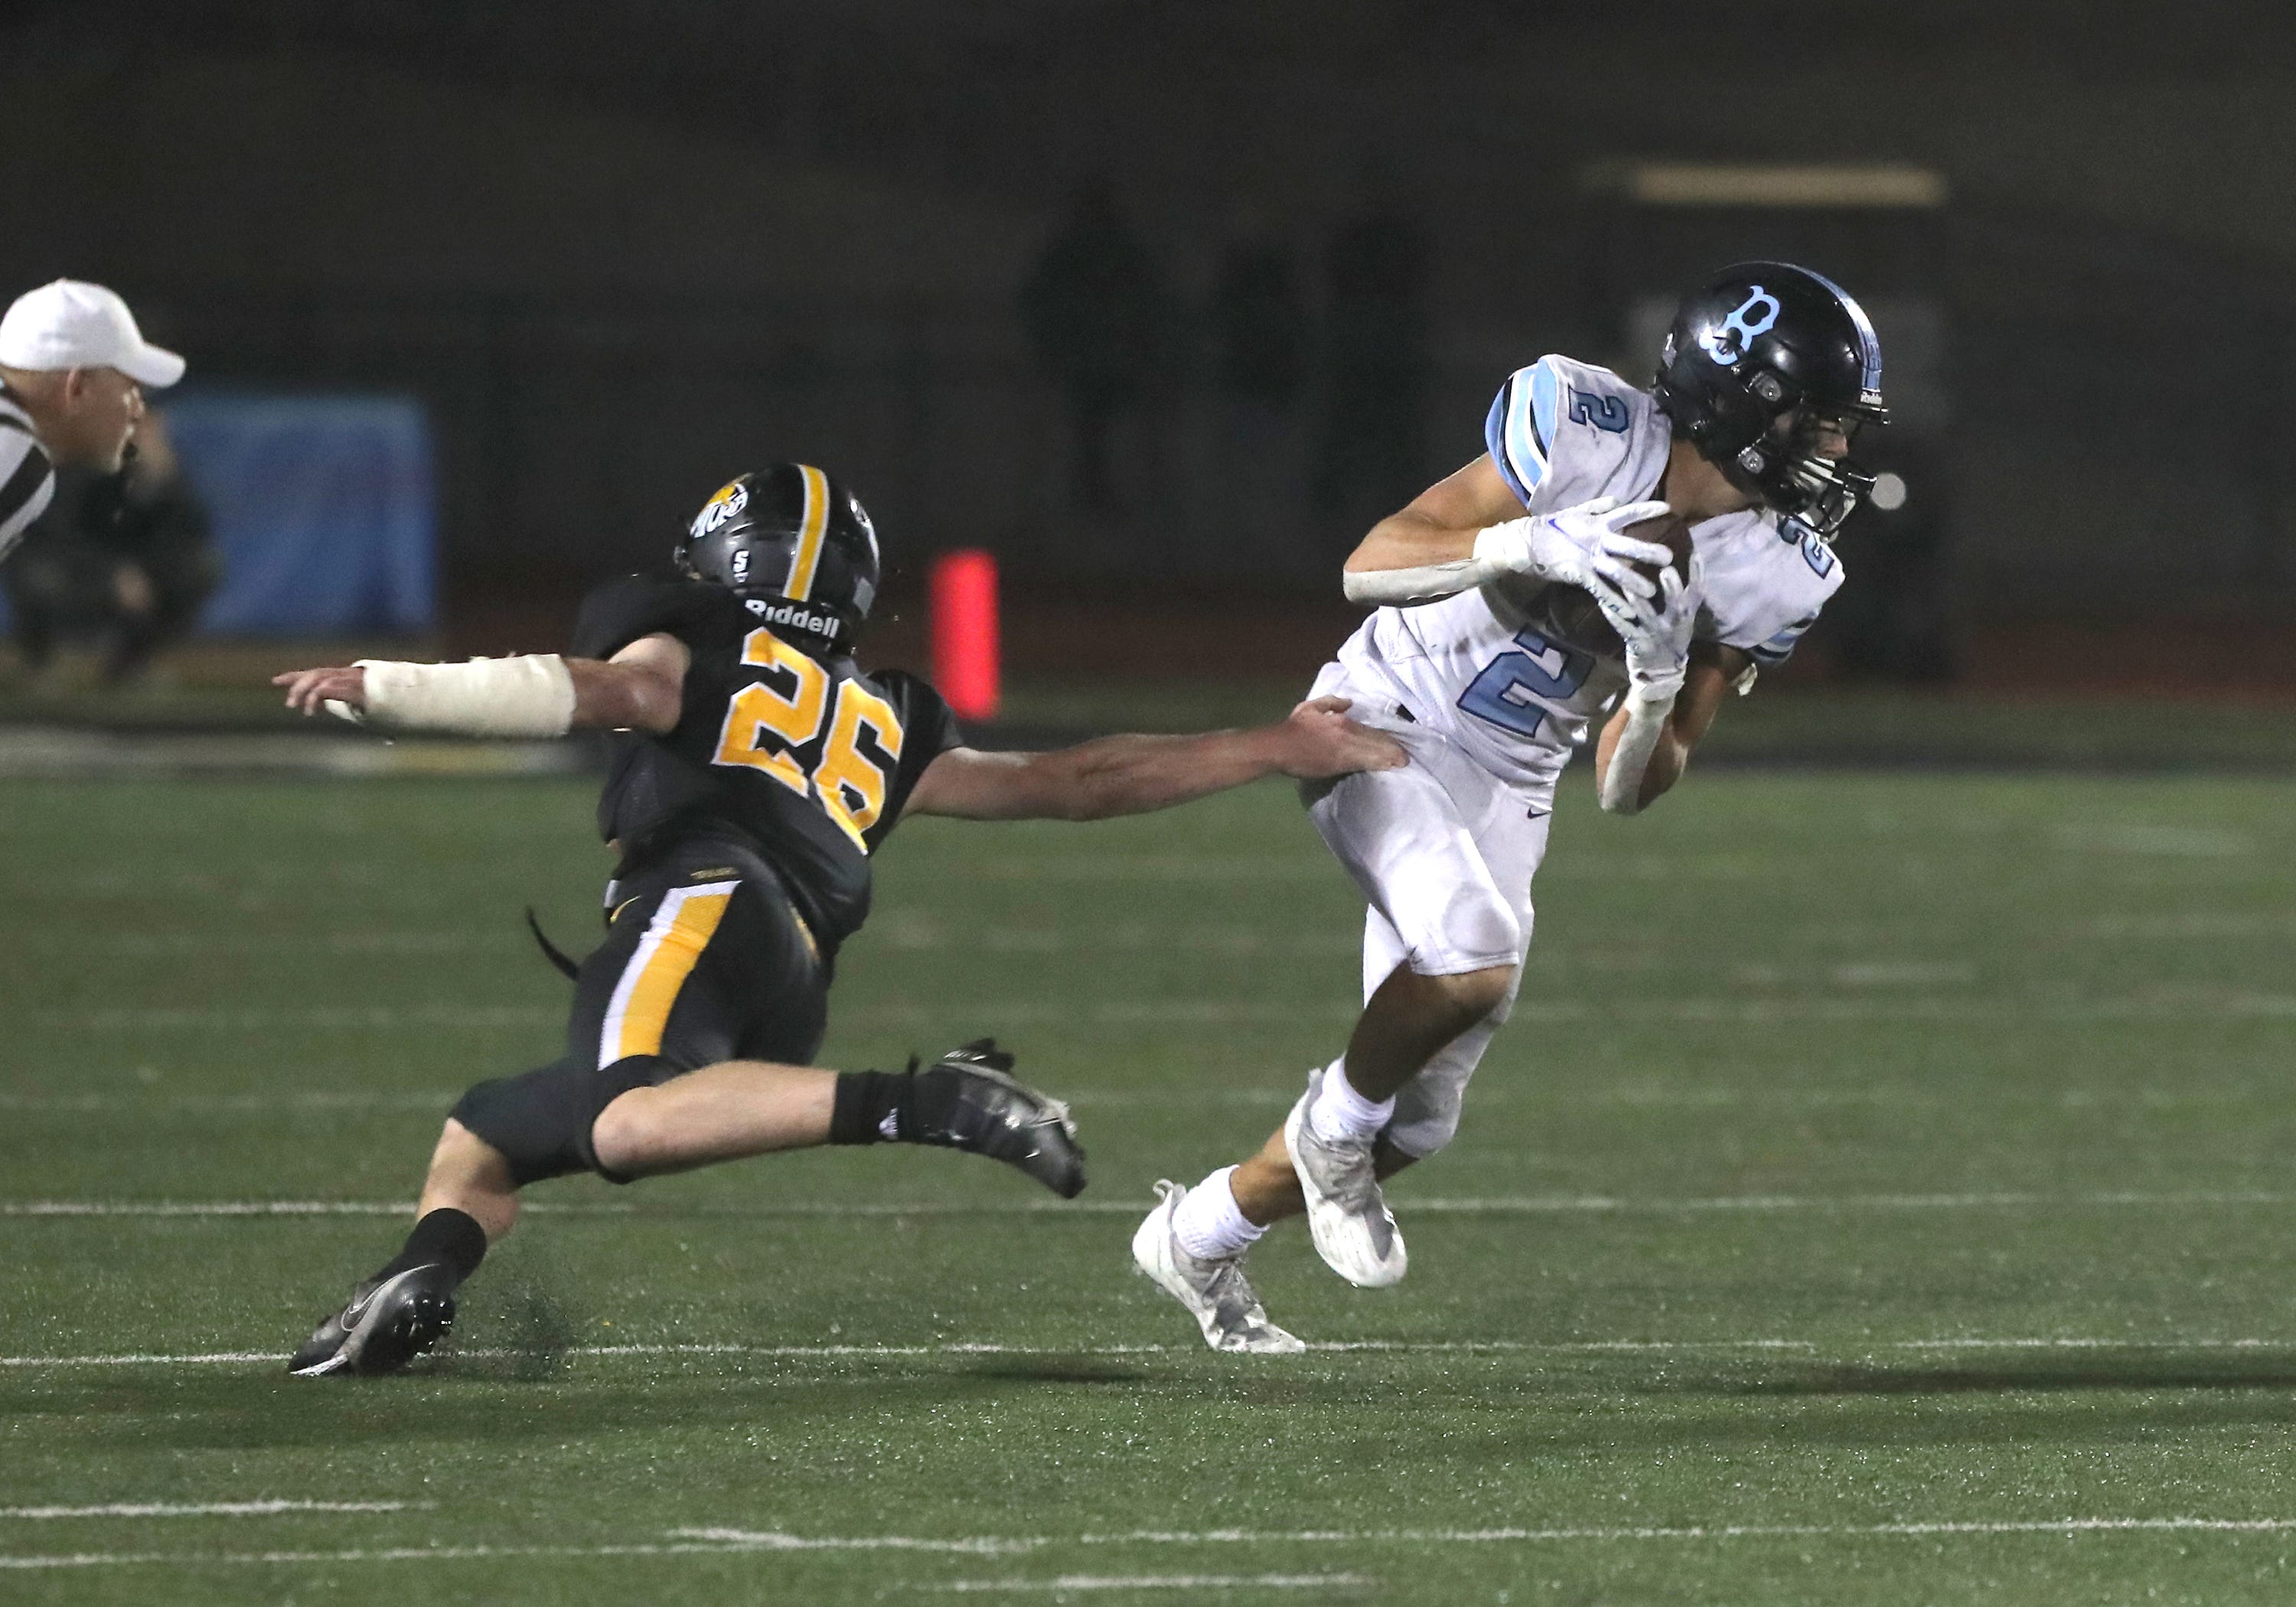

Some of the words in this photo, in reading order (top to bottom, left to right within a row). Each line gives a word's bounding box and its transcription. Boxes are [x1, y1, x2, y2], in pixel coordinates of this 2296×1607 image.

[1567, 383, 1629, 434] 2
[1776, 515, 1835, 579] 2
[745, 599, 840, 639] Riddell
[1456, 624, 1596, 738] 2
[710, 625, 904, 856] 26
